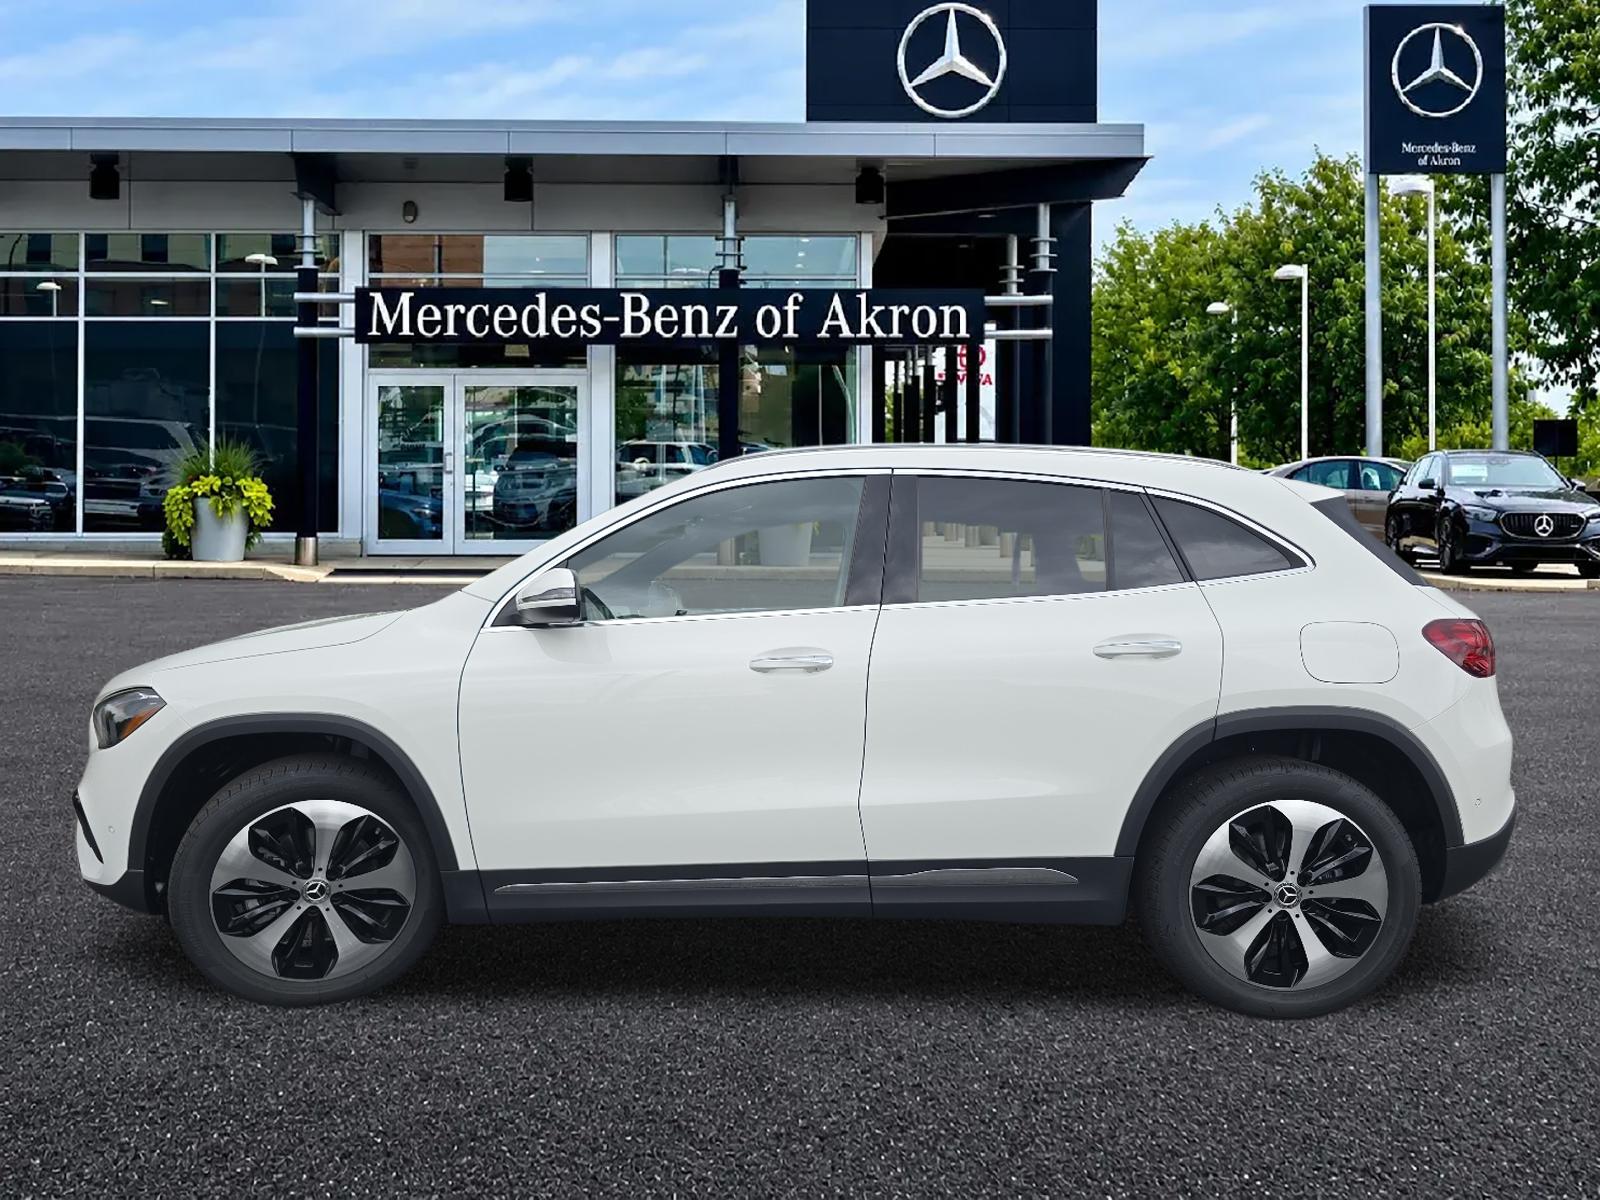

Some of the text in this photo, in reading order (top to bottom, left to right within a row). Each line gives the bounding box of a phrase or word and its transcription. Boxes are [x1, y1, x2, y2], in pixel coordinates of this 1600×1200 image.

[1401, 142, 1476, 154] Mercedes-Benz
[1418, 154, 1461, 166] of Akron
[367, 291, 971, 338] Mercedes-Benz of Akron
